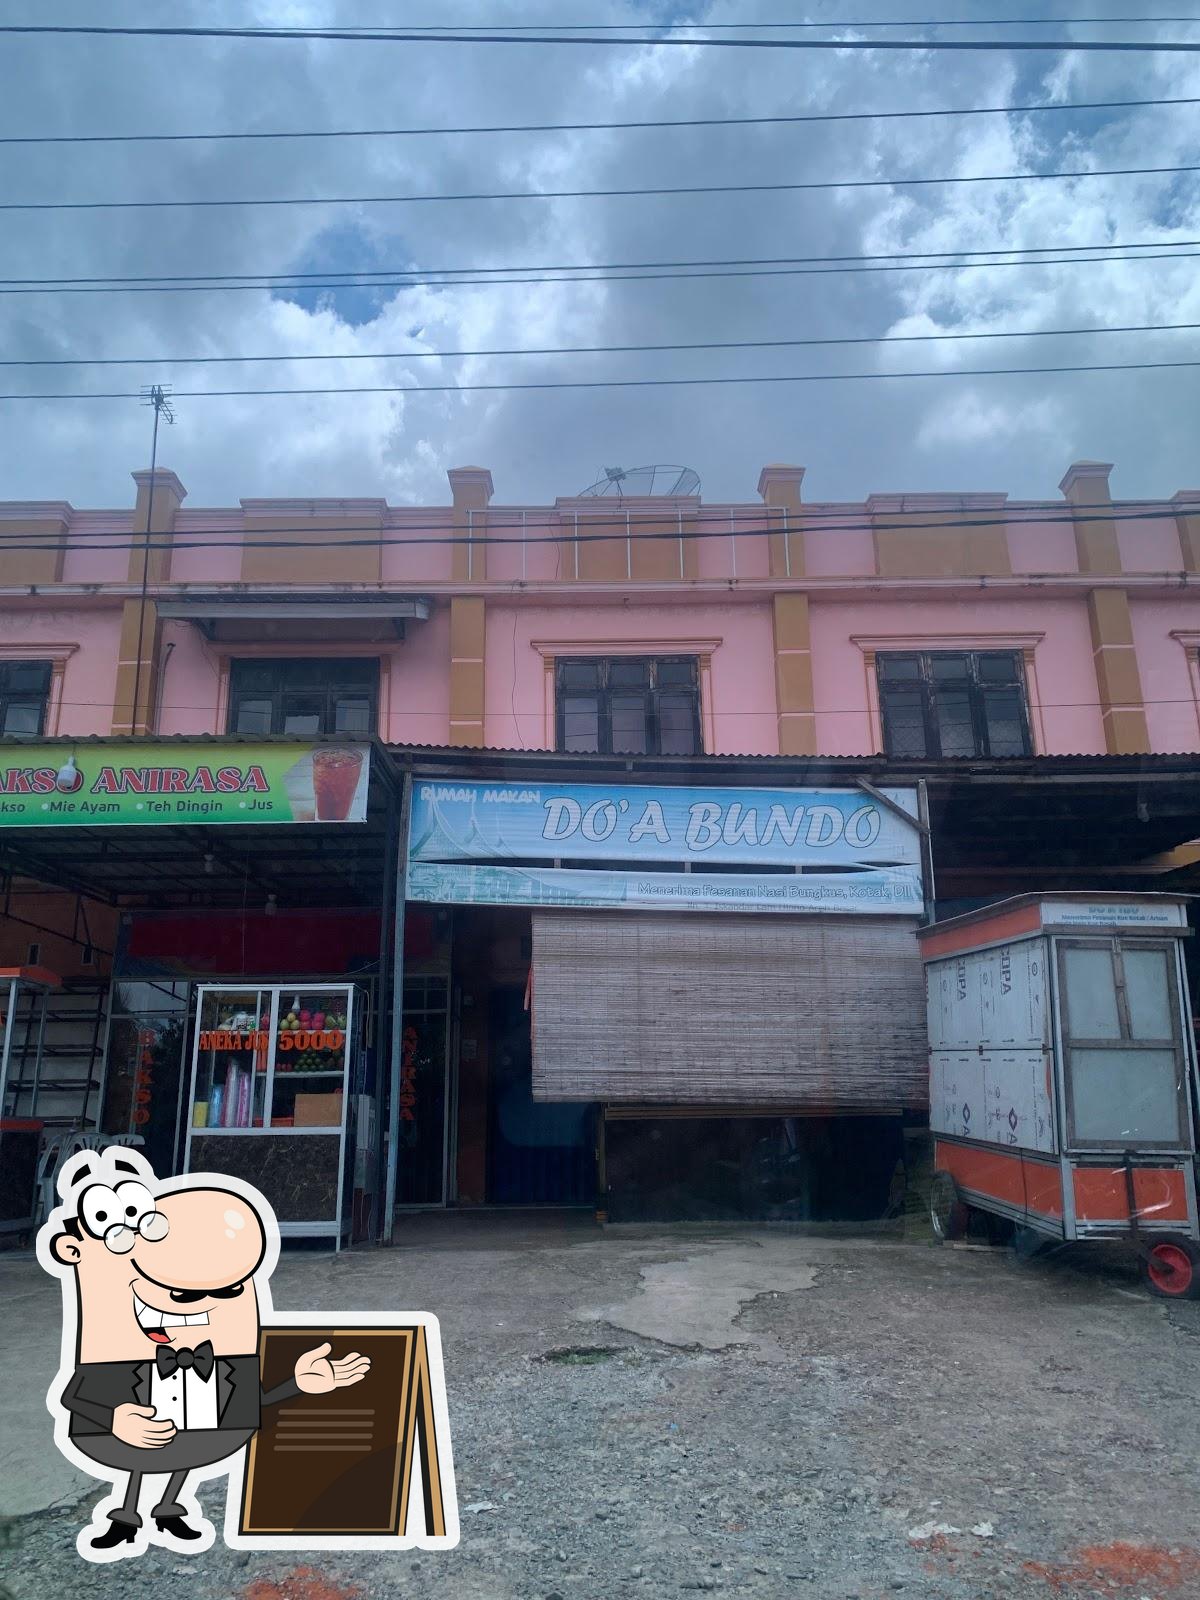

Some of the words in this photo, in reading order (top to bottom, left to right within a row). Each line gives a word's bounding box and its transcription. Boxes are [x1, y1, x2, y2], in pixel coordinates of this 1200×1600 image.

[0, 766, 84, 794] KSO
[91, 765, 270, 794] ANIRASA
[420, 785, 477, 802] RUMAH
[482, 789, 541, 803] MAKAN
[0, 801, 25, 813] kso
[50, 801, 75, 812] Mie
[80, 801, 120, 815] Ayam
[146, 800, 171, 812] Teh
[176, 799, 223, 814] Dingin
[248, 798, 274, 811] Jus
[685, 801, 882, 852] BUNDO
[638, 882, 701, 898] Menerima
[702, 883, 756, 898] Pesanan
[757, 885, 787, 898] Nasi
[790, 885, 848, 901] Bungkus,
[849, 886, 892, 899] Kotak,
[198, 1030, 242, 1051] ANEKA
[278, 1028, 345, 1051] 5000
